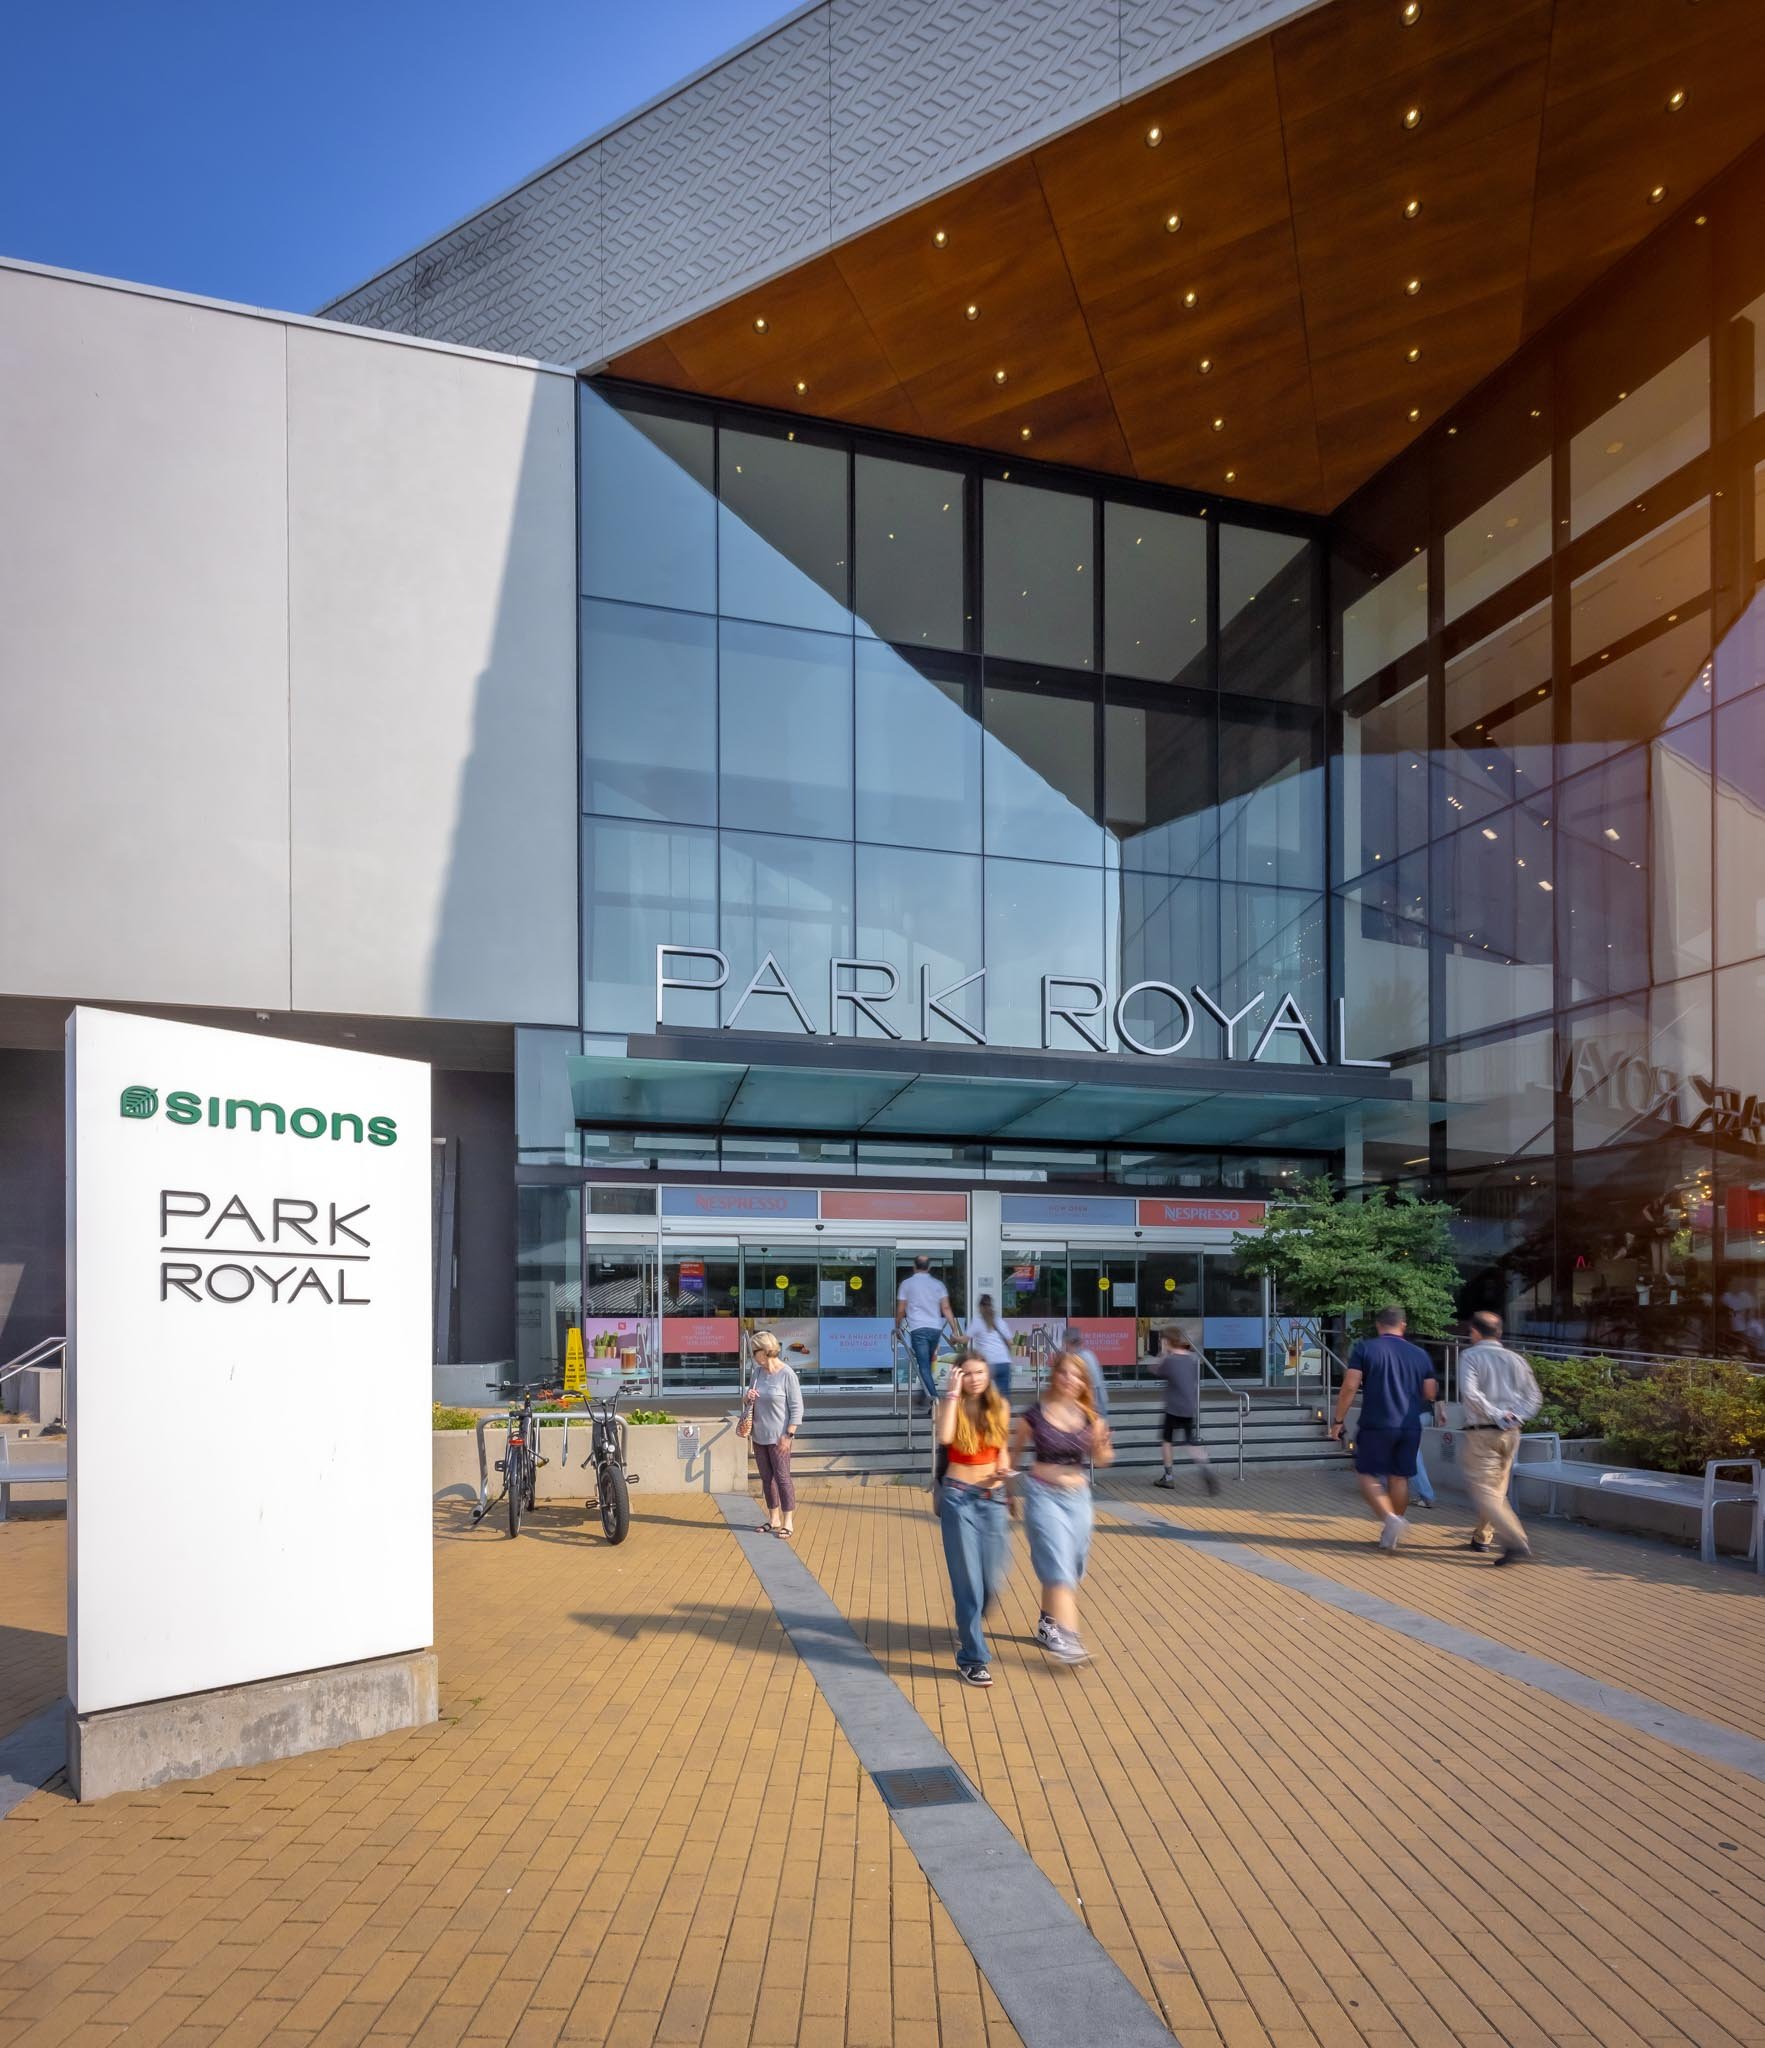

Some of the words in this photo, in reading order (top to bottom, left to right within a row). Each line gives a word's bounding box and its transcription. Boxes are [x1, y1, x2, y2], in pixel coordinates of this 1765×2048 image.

[656, 944, 988, 1046] PARK
[1040, 974, 1392, 1067] ROYAL
[165, 1091, 398, 1146] simons
[160, 1190, 371, 1248] PARK
[696, 1193, 787, 1211] NESPRESSO
[1162, 1204, 1240, 1222] NESPRESSO
[160, 1262, 371, 1305] ROYAL
[833, 1285, 843, 1303] 5
